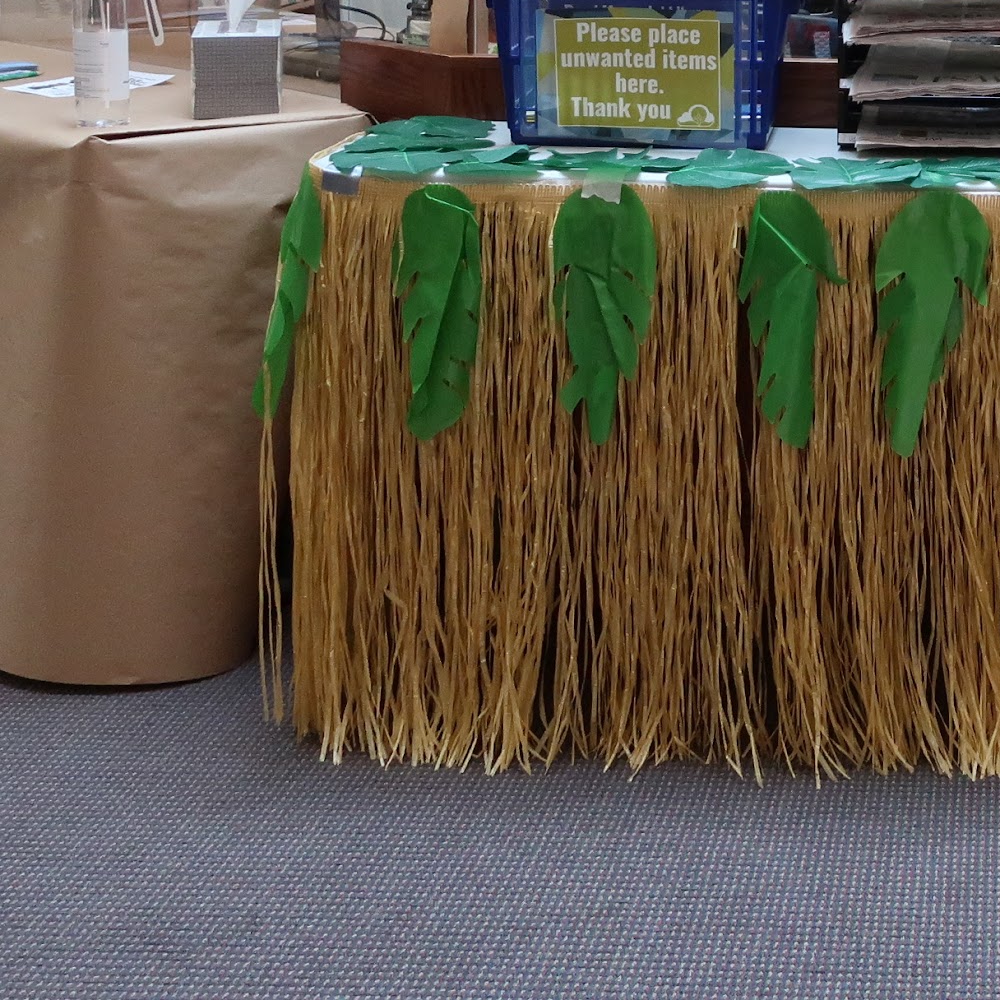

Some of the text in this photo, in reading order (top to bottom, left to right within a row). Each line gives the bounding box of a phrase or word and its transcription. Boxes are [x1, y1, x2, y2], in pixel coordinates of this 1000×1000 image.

[576, 22, 700, 48] Please place
[560, 48, 717, 71] unwanted items
[615, 72, 664, 94] here.
[571, 96, 671, 122] Thank you
